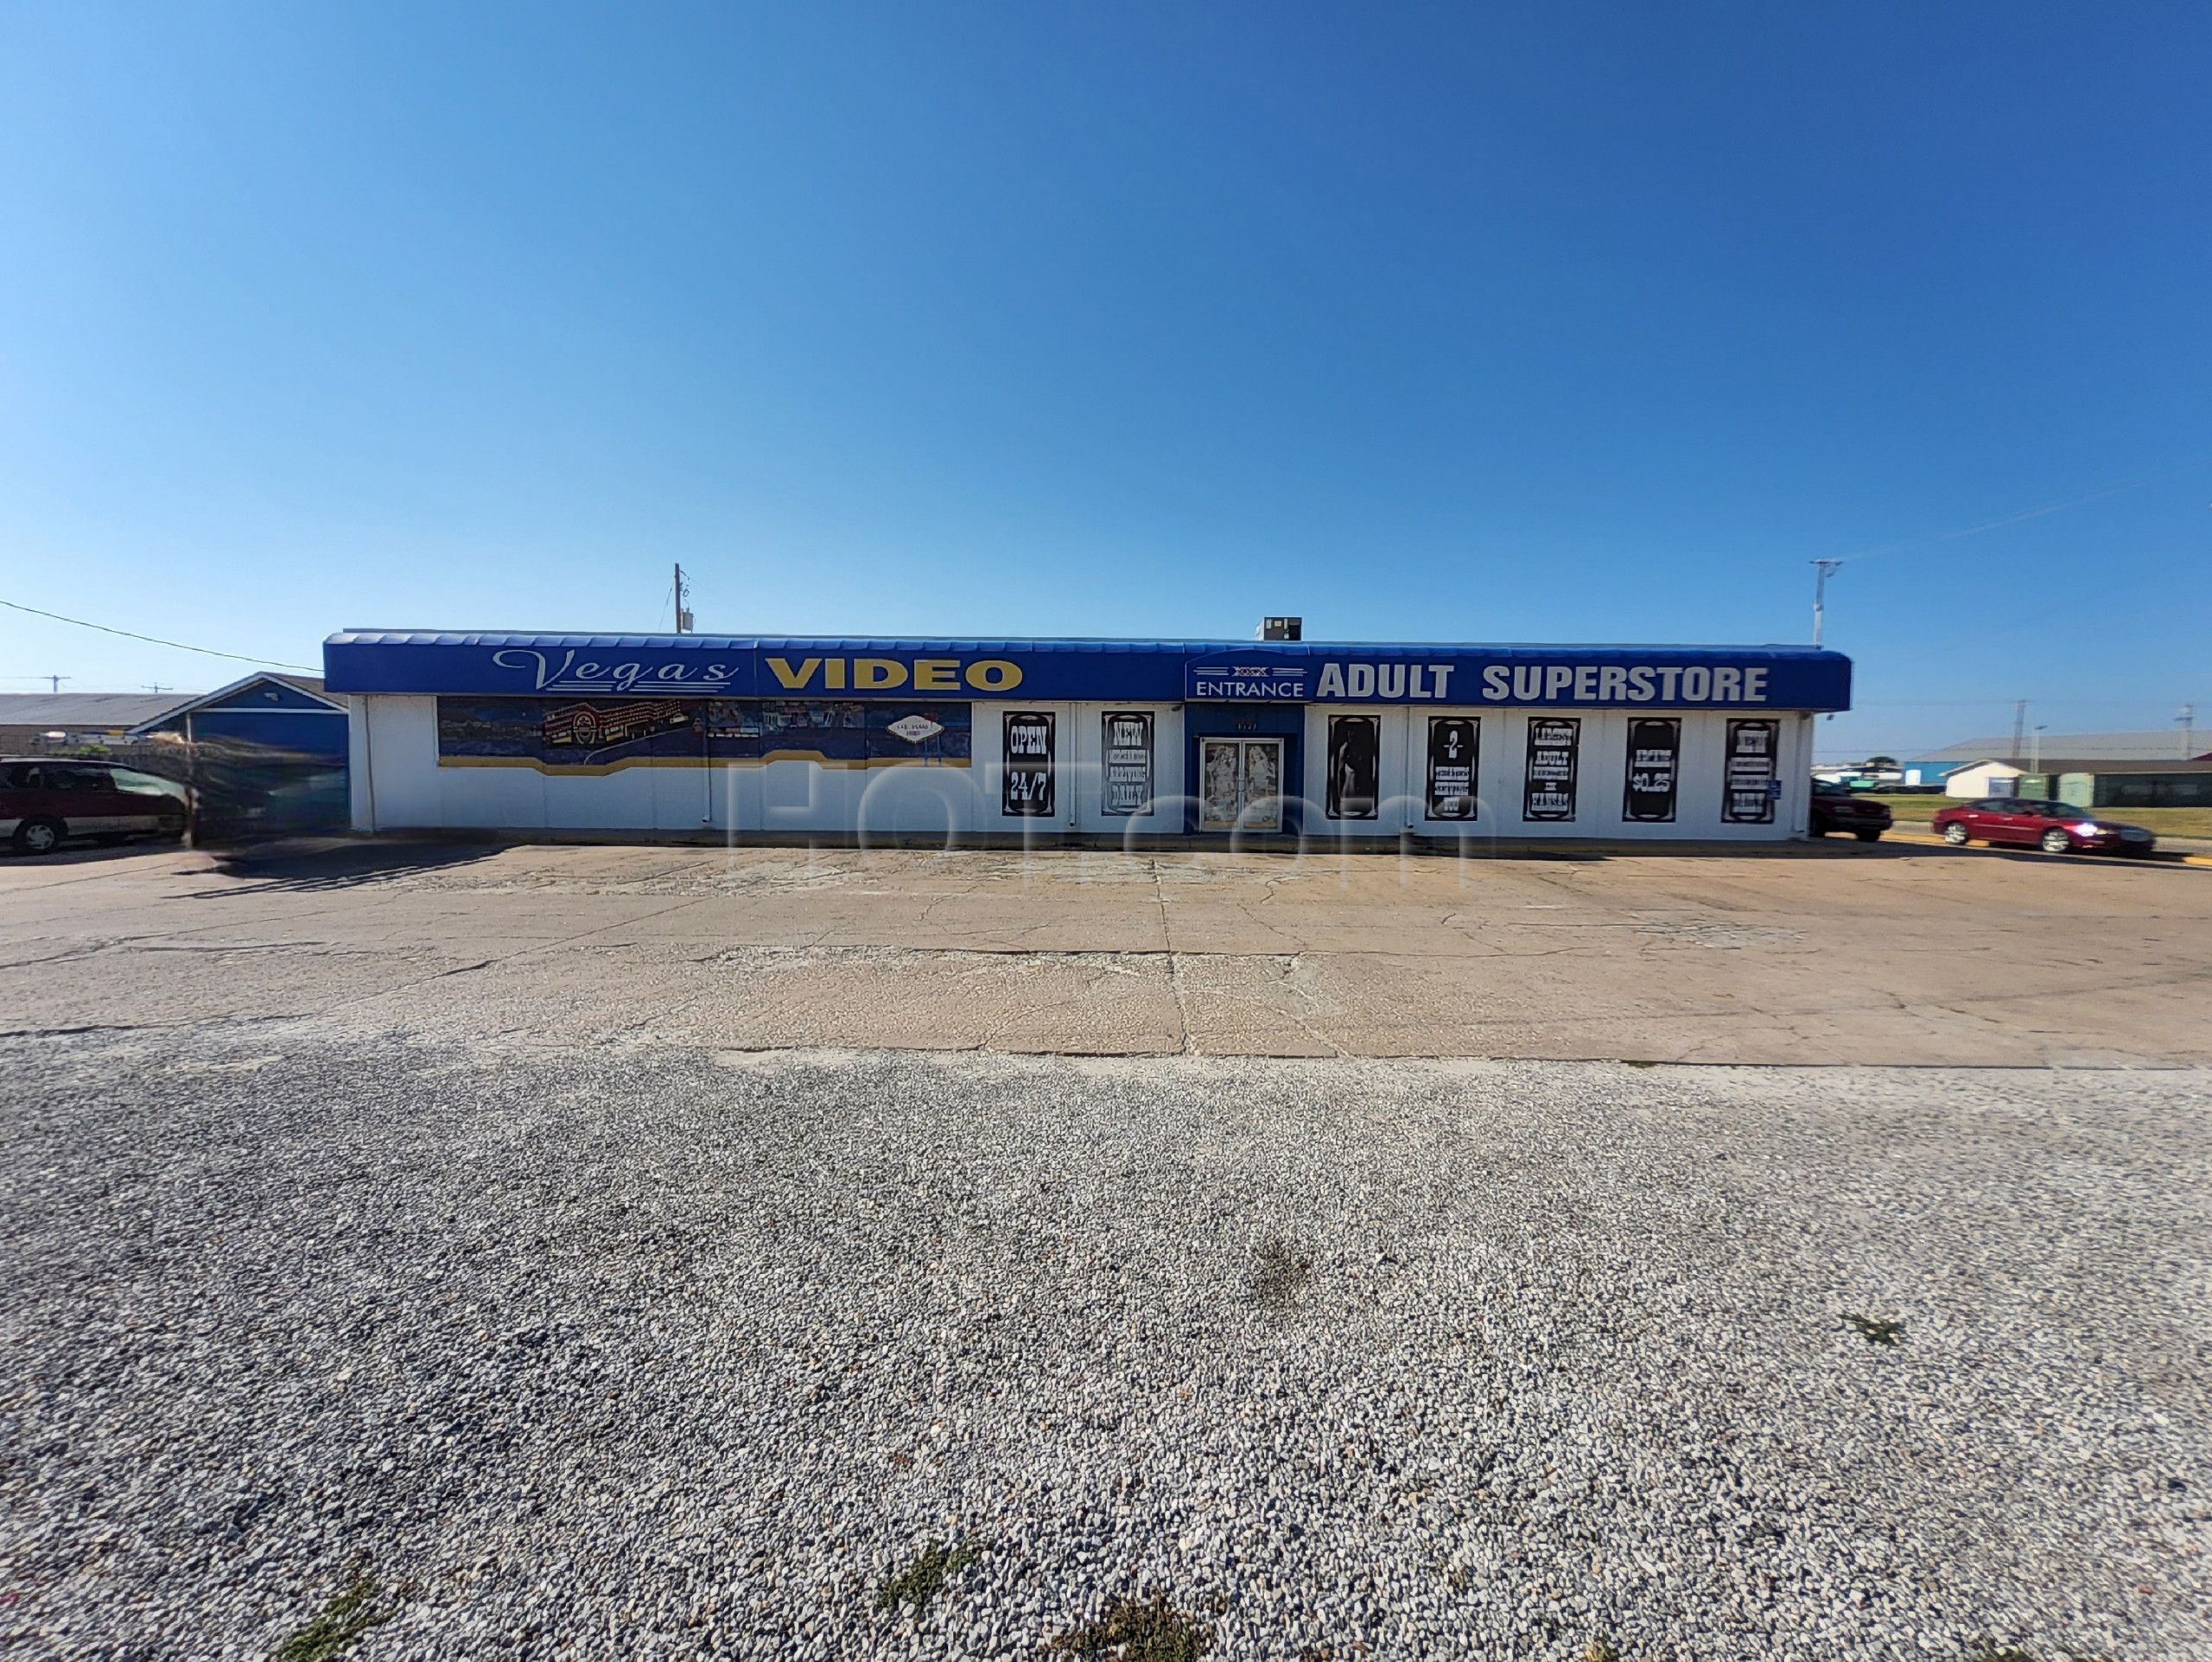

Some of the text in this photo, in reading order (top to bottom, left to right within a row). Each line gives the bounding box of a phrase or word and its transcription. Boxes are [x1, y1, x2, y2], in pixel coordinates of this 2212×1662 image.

[492, 648, 1023, 691] Vegas VIDEO
[1231, 665, 1270, 678] XXX
[1317, 663, 1769, 703] ADULT SUPERSTORE
[1196, 681, 1304, 698] ENTRANCE
[1010, 725, 1047, 755] OPEN
[1113, 721, 1144, 747] NEW
[1010, 771, 1047, 801] 24/7
[1110, 784, 1144, 806] DAILY
